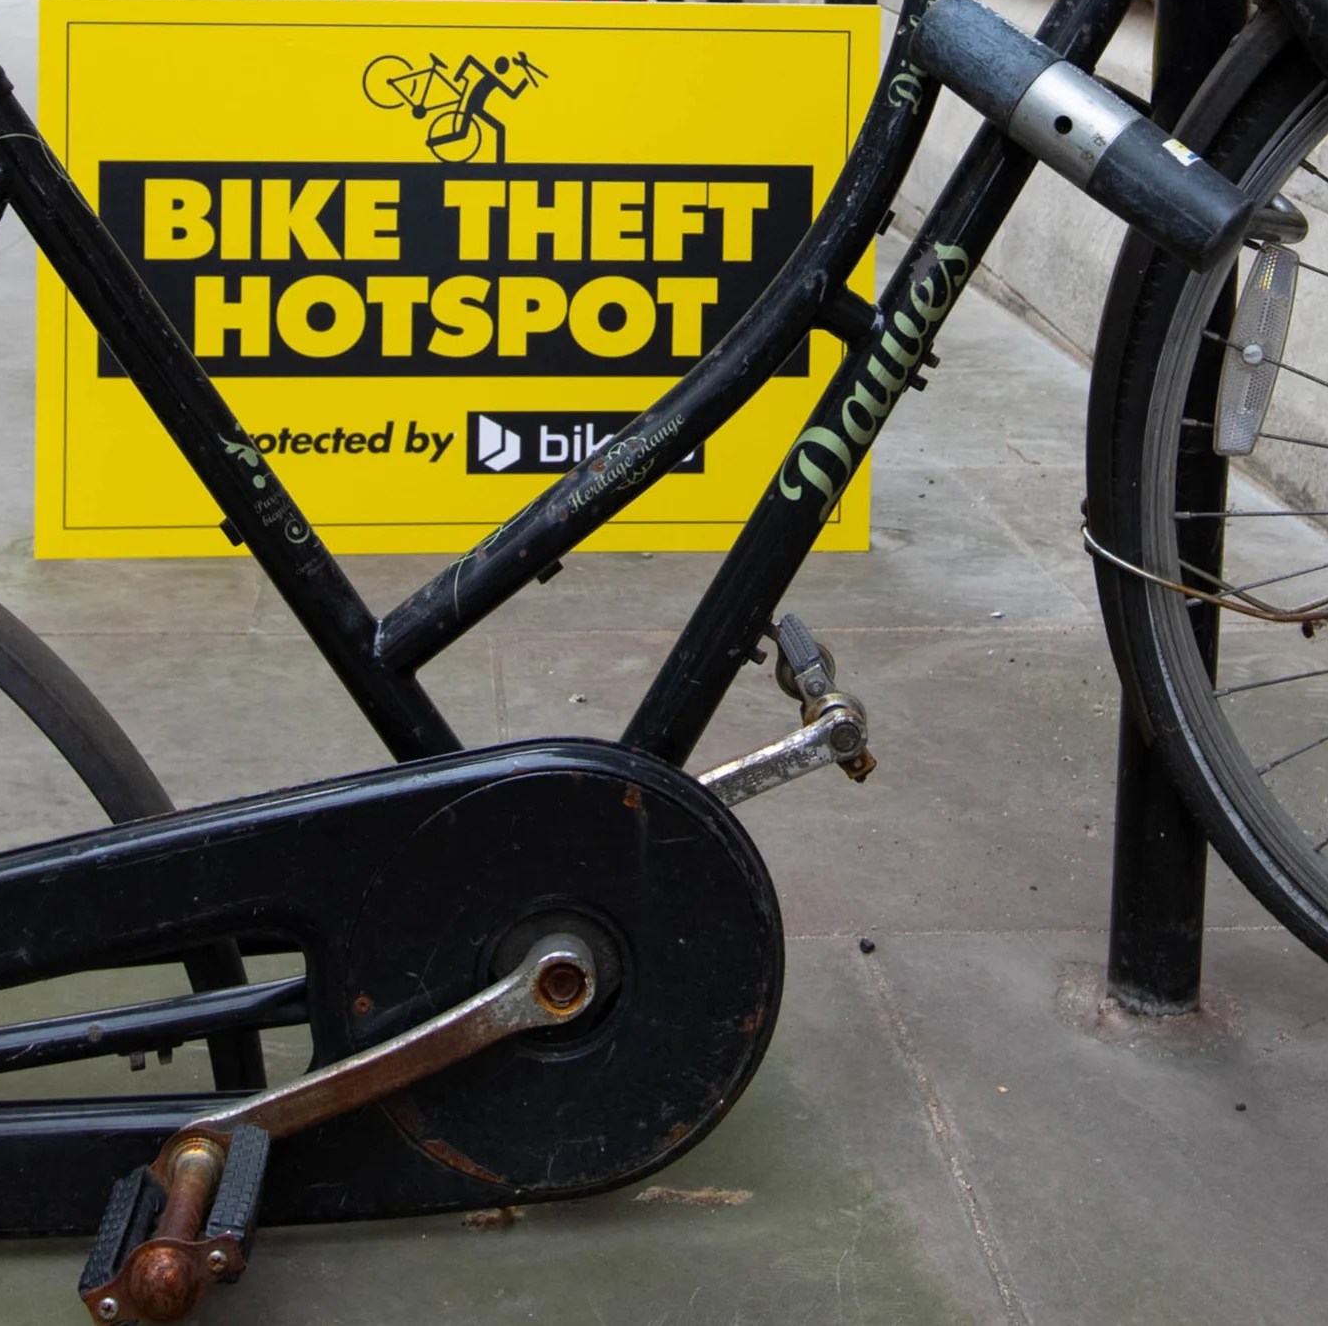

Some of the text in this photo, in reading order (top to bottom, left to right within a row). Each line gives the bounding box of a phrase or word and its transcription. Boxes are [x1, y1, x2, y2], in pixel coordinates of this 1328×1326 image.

[144, 179, 769, 262] BIKE THEFT
[194, 274, 718, 358] HOTSPOT
[779, 241, 969, 523] Dawes
[404, 421, 457, 463] by
[568, 413, 685, 514] Heritage Range
